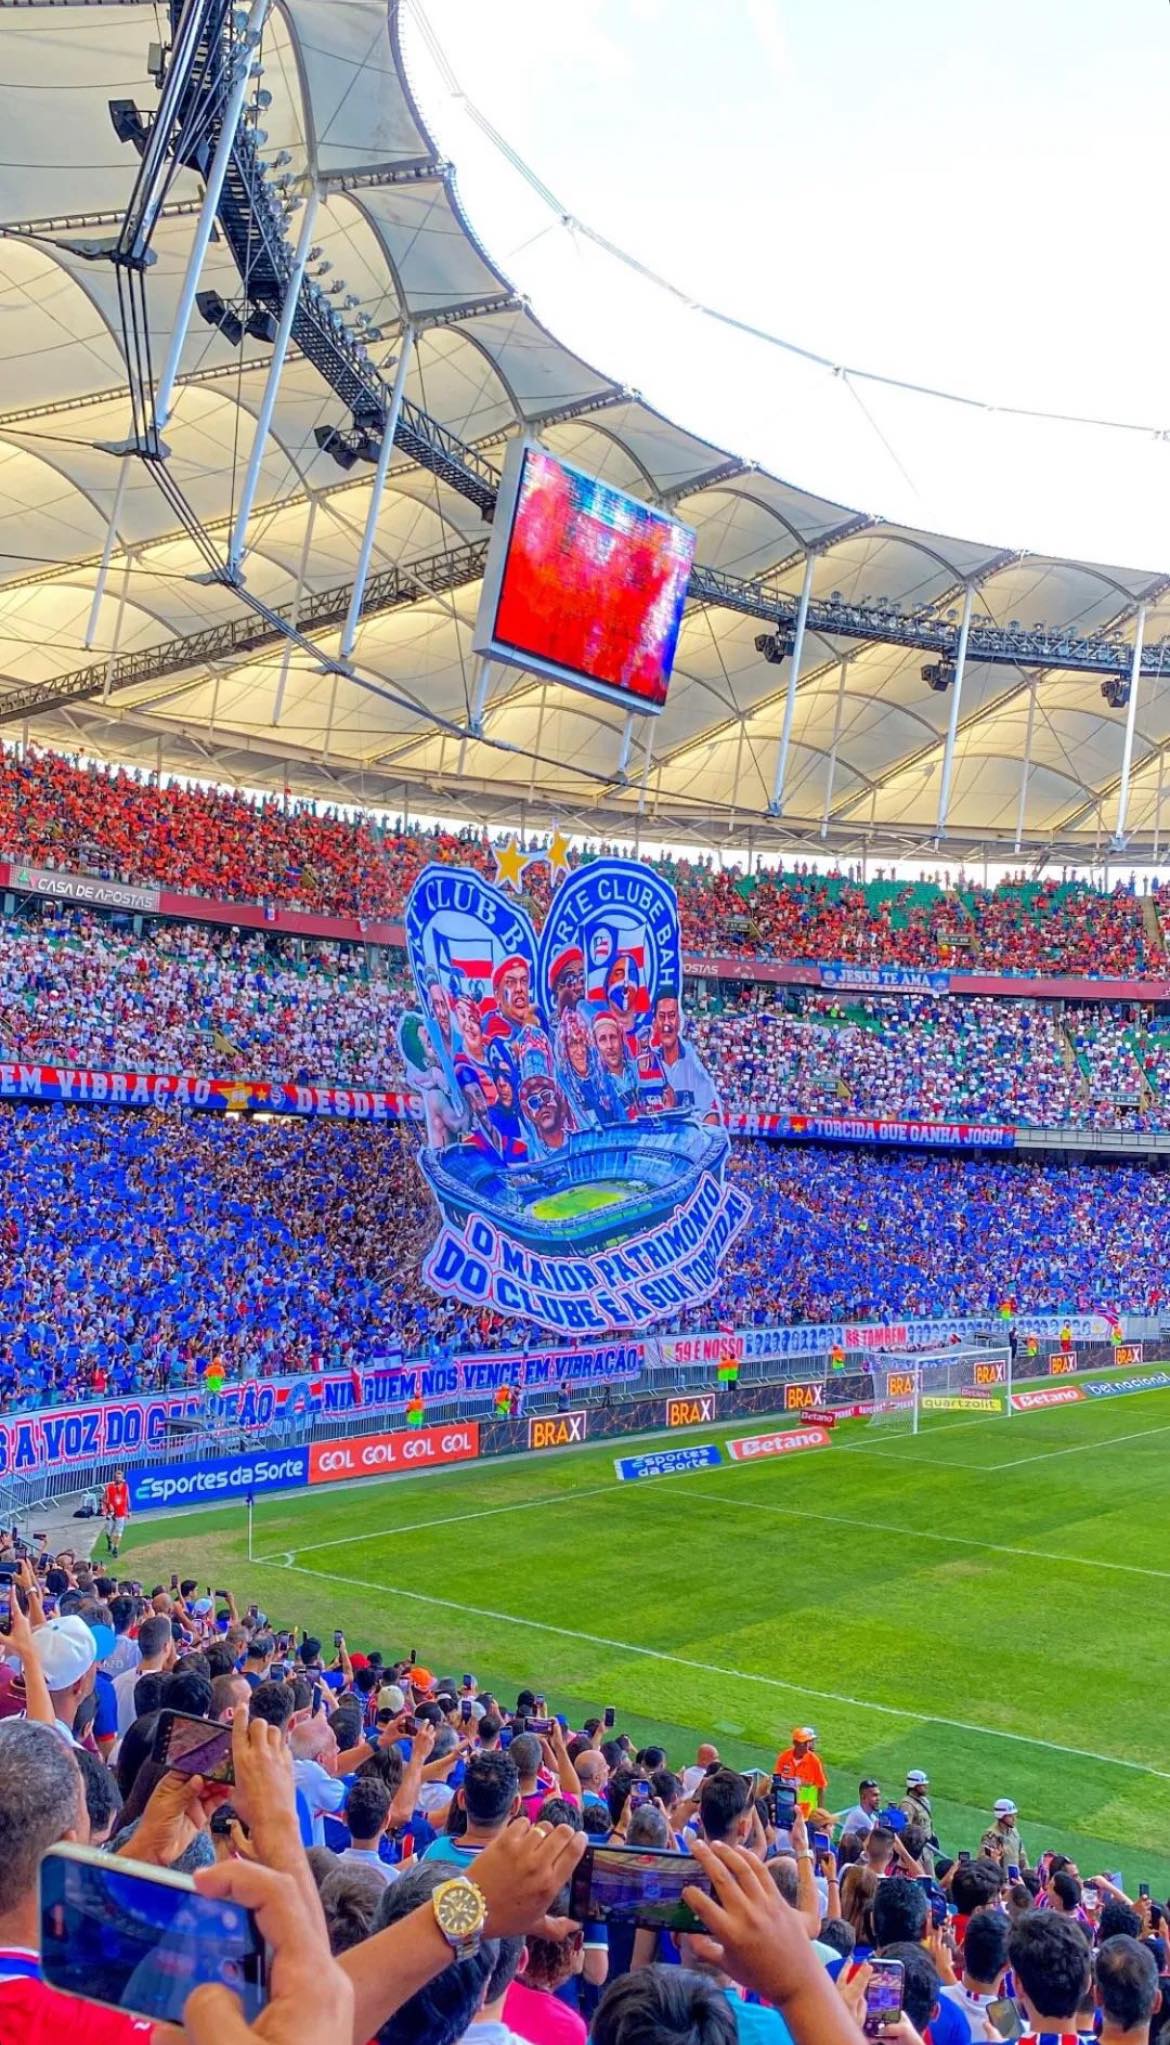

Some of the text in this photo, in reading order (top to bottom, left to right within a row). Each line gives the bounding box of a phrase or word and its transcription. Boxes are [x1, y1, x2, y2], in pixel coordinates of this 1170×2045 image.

[38, 878, 153, 908] CASA DE APOSTAS
[598, 880, 665, 924] CLUBE
[839, 969, 931, 987] JESUS TE AMA
[1, 1066, 42, 1095] EM
[296, 1086, 387, 1119] DESDE
[816, 1119, 876, 1139] TORCIDA
[910, 1126, 960, 1144] GANHA
[964, 1128, 1003, 1145] JOGO!
[472, 1178, 721, 1292] O MAIOR PATRIMÔNIO
[434, 1238, 488, 1295] DO
[496, 1276, 606, 1327] CLUBE
[597, 1291, 630, 1322] É
[621, 1292, 653, 1320] A
[640, 1272, 694, 1309] SUA
[704, 1338, 743, 1360] NOSSO
[1116, 1347, 1141, 1365] BRAX
[422, 1368, 457, 1397] NOS
[464, 1361, 520, 1390] VENCE
[525, 1357, 550, 1385] EM
[976, 1364, 1003, 1383] BRAX
[1052, 1355, 1074, 1374] BRAX
[787, 1385, 822, 1409] BRAX
[924, 1398, 994, 1409] quartzolit
[1019, 1390, 1078, 1407] Betano
[670, 1399, 714, 1427] BRAX
[801, 1410, 833, 1422] Betano
[15, 1425, 36, 1468] A
[43, 1414, 100, 1461] VOZ
[106, 1409, 141, 1449] DO
[533, 1416, 582, 1448] BRAX
[741, 1432, 823, 1456] Betano
[318, 1432, 472, 1472] GOL GOL GOL GOL
[632, 1447, 710, 1469] Esportes
[638, 1458, 711, 1478] da Sorte
[136, 1472, 228, 1501] Esportes
